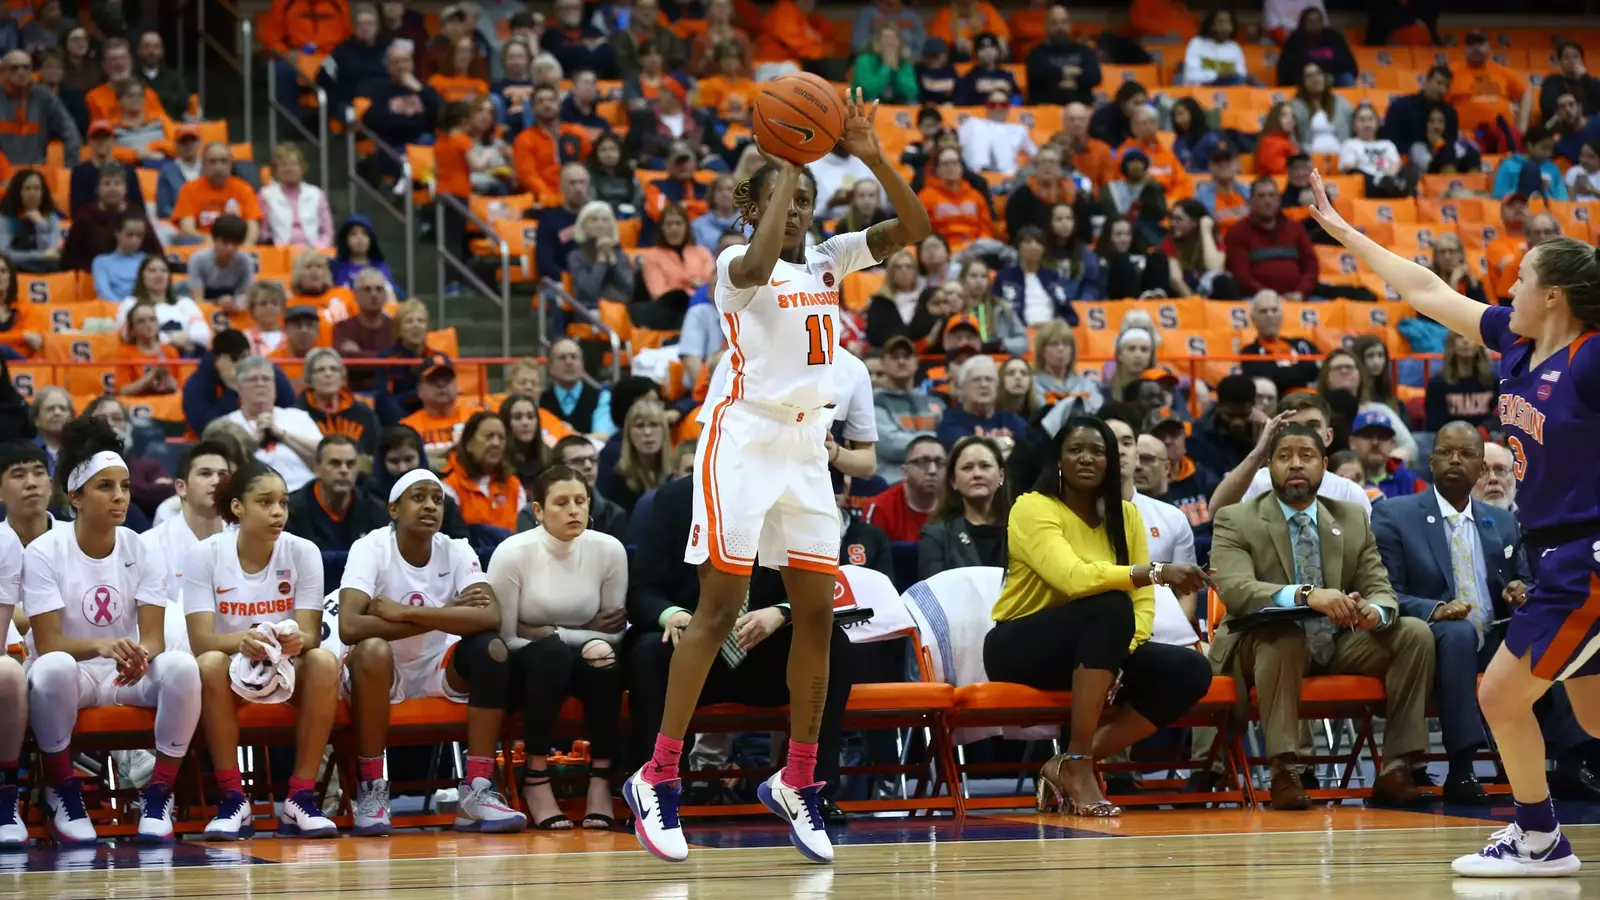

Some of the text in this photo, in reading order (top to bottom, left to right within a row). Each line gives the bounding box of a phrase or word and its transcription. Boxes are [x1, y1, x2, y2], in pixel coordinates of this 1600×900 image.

[28, 280, 48, 304] S
[1087, 306, 1106, 330] S
[1158, 305, 1178, 330] S
[1230, 307, 1249, 328] S
[1301, 310, 1319, 328] S
[71, 340, 91, 362] S
[805, 314, 834, 365] 11
[1187, 335, 1207, 357] S
[14, 372, 33, 396] S
[795, 411, 805, 423] S
[1498, 393, 1546, 446] EMSON
[1508, 436, 1528, 482] 3
[691, 523, 701, 547] S
[848, 544, 867, 566] S
[219, 597, 294, 616] SYRACUSE
